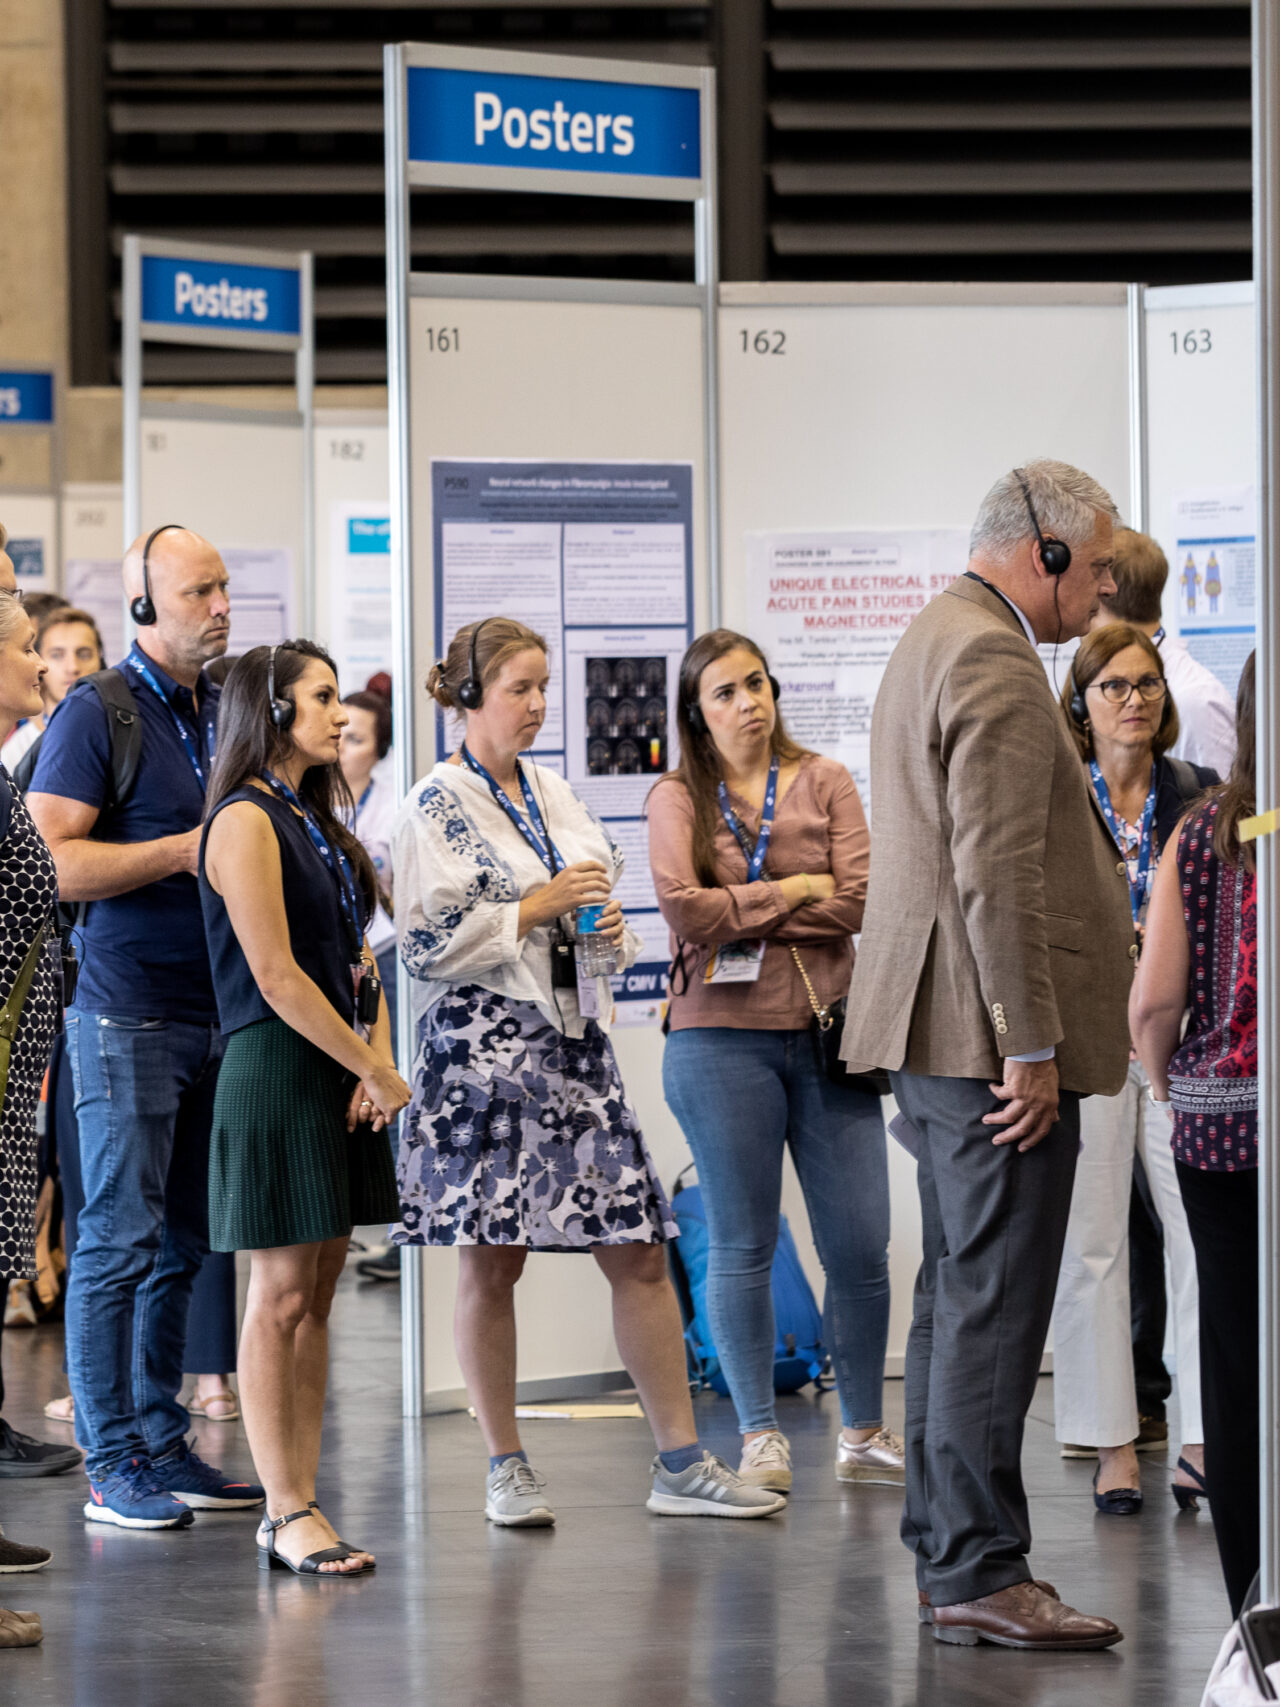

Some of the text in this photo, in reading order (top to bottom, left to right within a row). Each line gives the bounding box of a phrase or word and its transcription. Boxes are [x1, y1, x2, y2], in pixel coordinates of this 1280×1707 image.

[474, 92, 634, 155] Posters
[175, 272, 267, 321] Posters
[427, 328, 460, 352] 161
[741, 329, 786, 355] 162
[1170, 329, 1212, 354] 163
[330, 440, 365, 460] 182
[770, 577, 827, 592] UNIQUE
[832, 575, 923, 590] ELECTRICAL
[767, 594, 925, 611] ACUTE PAIN STUDIES
